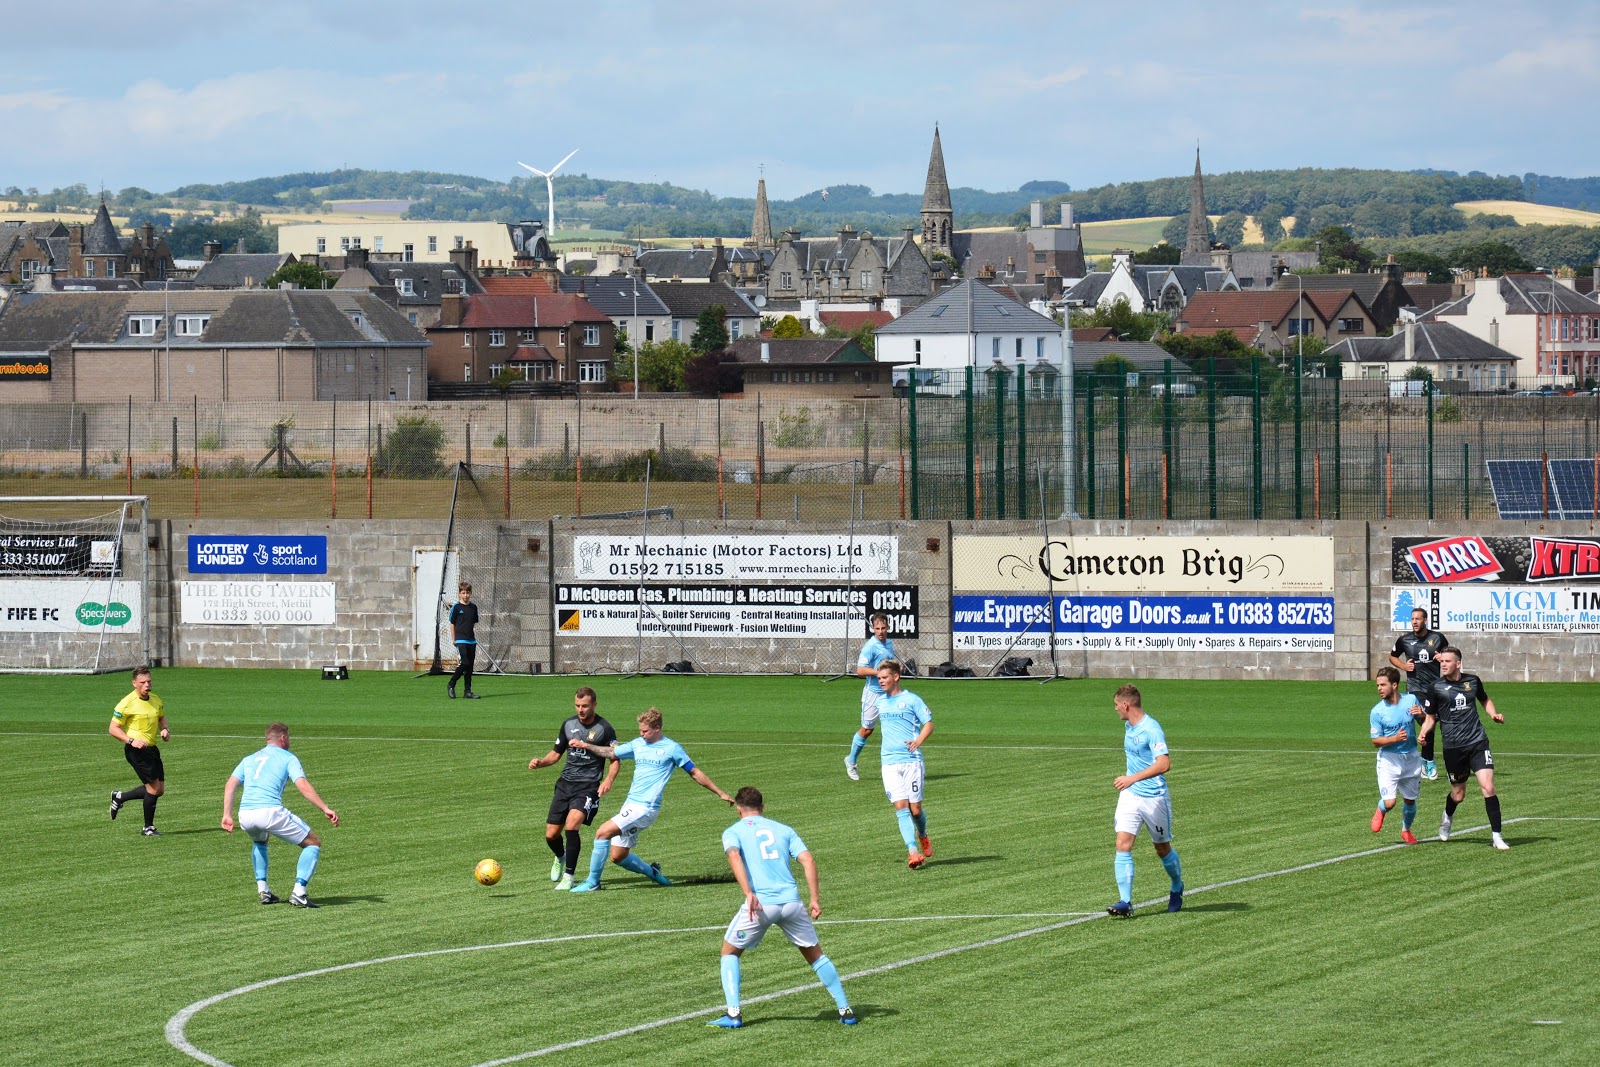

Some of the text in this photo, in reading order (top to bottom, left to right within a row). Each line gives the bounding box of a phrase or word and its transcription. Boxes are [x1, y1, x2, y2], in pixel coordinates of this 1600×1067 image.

[0, 363, 49, 374] rmfoods
[0, 536, 78, 547] al Services Ltd.
[197, 544, 249, 554] LOTTERY
[272, 544, 302, 555] sport
[609, 544, 863, 559] Mr Mechanic (Motor Factors) Ltd
[0, 553, 66, 565] 333 351007
[197, 555, 244, 565] FUNDED
[272, 555, 317, 565] scotland
[1039, 541, 1243, 583] Cameron Brig
[1421, 539, 1491, 578] BARR
[1530, 540, 1600, 577] XTR
[609, 563, 724, 575] 01592 715185
[739, 565, 862, 573] www.mrmechanic.info
[184, 584, 331, 598] THE BRIG TAVERN
[559, 587, 867, 604] D McQueen Gas, Plumbing & Heating Services
[221, 600, 244, 609] High
[247, 600, 278, 609] Street,
[281, 600, 312, 608] Methil
[872, 591, 912, 610] 01334
[1489, 591, 1557, 610] MGM
[7, 608, 37, 620] FIFE
[42, 608, 59, 621] FC
[202, 609, 313, 622] 01333 300 000
[583, 609, 598, 618] LPG
[607, 610, 638, 618] Natural
[640, 610, 656, 618] Gas
[662, 610, 688, 618] Boiler
[690, 610, 731, 620] Servicing
[741, 611, 772, 620] Central
[774, 612, 808, 621] Heating
[810, 611, 865, 620] Installatons
[1059, 599, 1123, 629] Garage
[1212, 602, 1224, 624] T:
[1228, 602, 1273, 625] 01383
[1277, 602, 1333, 625] 852753
[1431, 591, 1440, 629] TIMBER
[1447, 611, 1500, 622] Scotlands
[1504, 612, 1532, 622] Local
[1536, 611, 1575, 622] Timber
[636, 623, 807, 633] Underground Pipework Fusion Welding
[869, 614, 916, 633] 9144
[1466, 622, 1499, 630] EASTFIELD
[964, 636, 975, 645] All
[977, 636, 1001, 648] Types
[1005, 636, 1013, 645] of
[1015, 636, 1046, 648] Garage
[1082, 636, 1112, 648] Supply
[1115, 637, 1122, 645] &
[1125, 637, 1136, 646] Fit
[1145, 637, 1175, 649] Supply
[1177, 637, 1196, 649] Only
[1205, 638, 1235, 649] Spares
[1238, 638, 1246, 647] &
[1249, 638, 1282, 649] Repairs
[1291, 638, 1333, 649] Servicing
[254, 756, 270, 780] 7
[911, 780, 919, 793] 6
[1155, 825, 1164, 836] 4
[755, 829, 779, 860] 2
